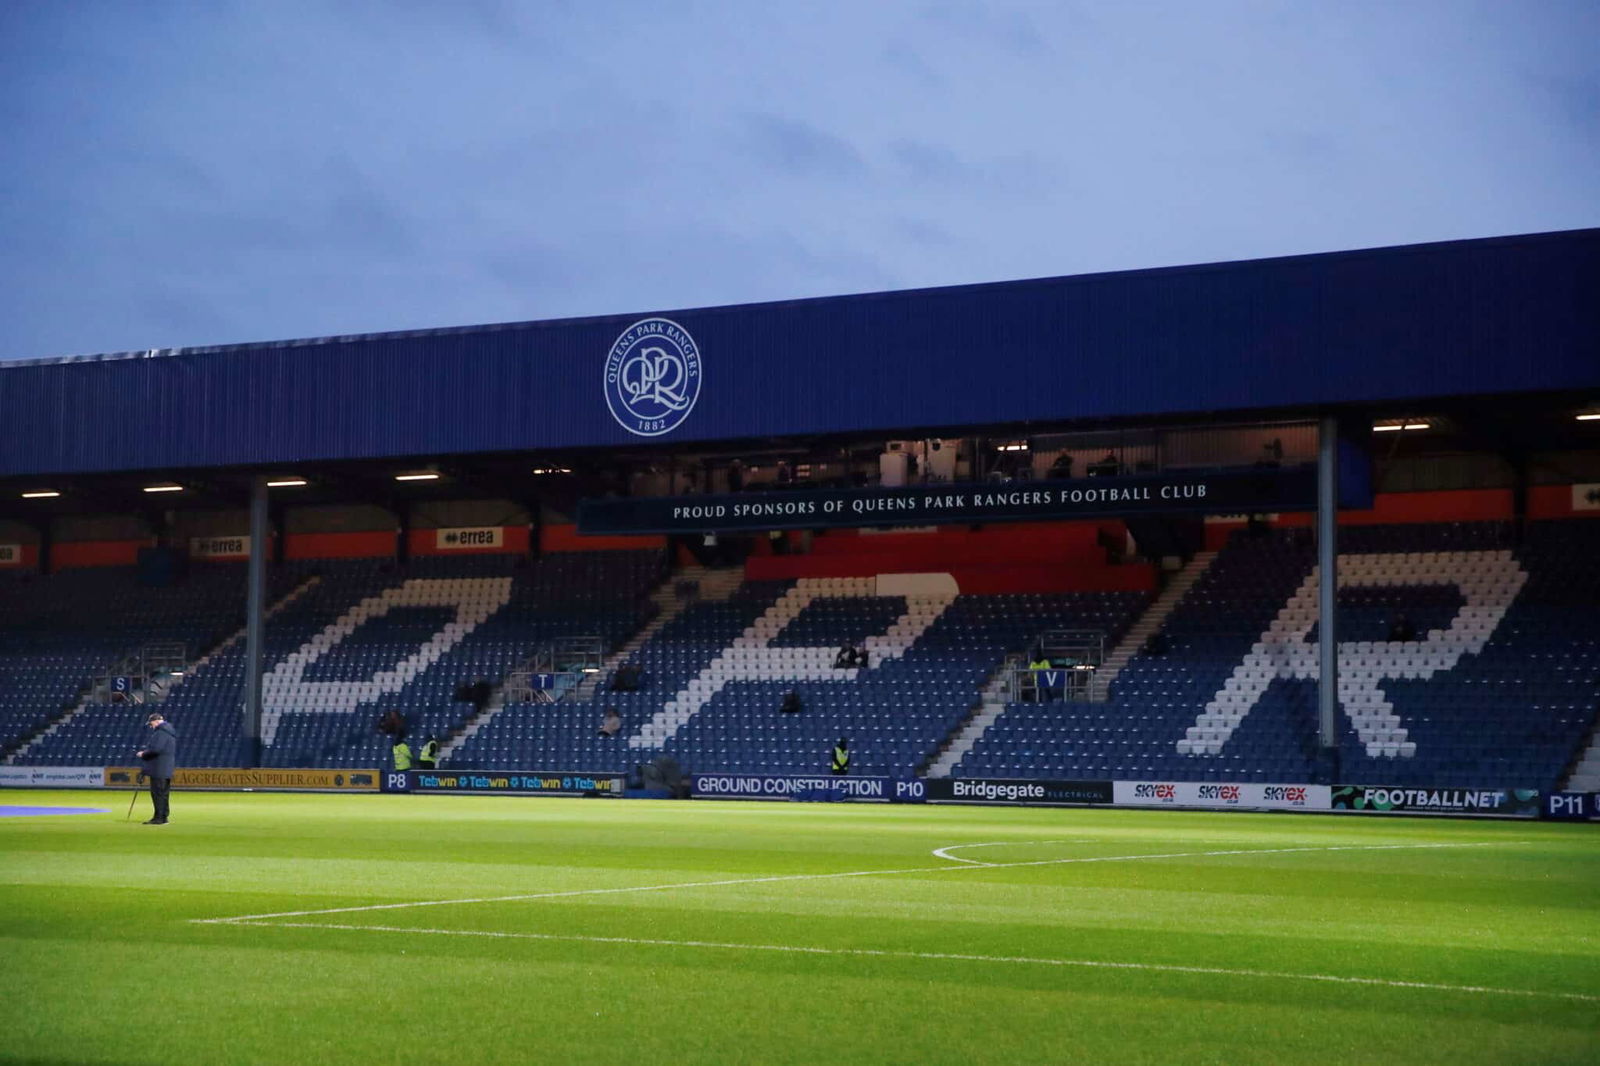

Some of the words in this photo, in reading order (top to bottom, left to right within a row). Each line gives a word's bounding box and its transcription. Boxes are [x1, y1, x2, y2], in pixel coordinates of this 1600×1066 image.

[608, 332, 635, 383] QUEENS
[637, 323, 665, 336] PARK
[666, 326, 698, 377] RANGERS
[638, 419, 666, 431] 1882
[673, 506, 726, 519] PROUD
[733, 501, 815, 517] SPONSORS
[823, 500, 844, 513] OF
[852, 497, 916, 513] QUEENS
[924, 495, 965, 509] PARK
[974, 491, 1051, 507] RANGERS
[1061, 488, 1151, 503] FOOTBALL
[1160, 485, 1207, 499] CLUB
[116, 677, 125, 691] S
[538, 674, 548, 688] T
[1045, 671, 1057, 687] V
[388, 773, 406, 788] P8
[697, 777, 761, 793] GROUND
[896, 781, 924, 797] P10
[953, 781, 1045, 799] Bridgegate
[1363, 789, 1504, 809] FOOTBALLNET
[1550, 795, 1583, 815] P11
